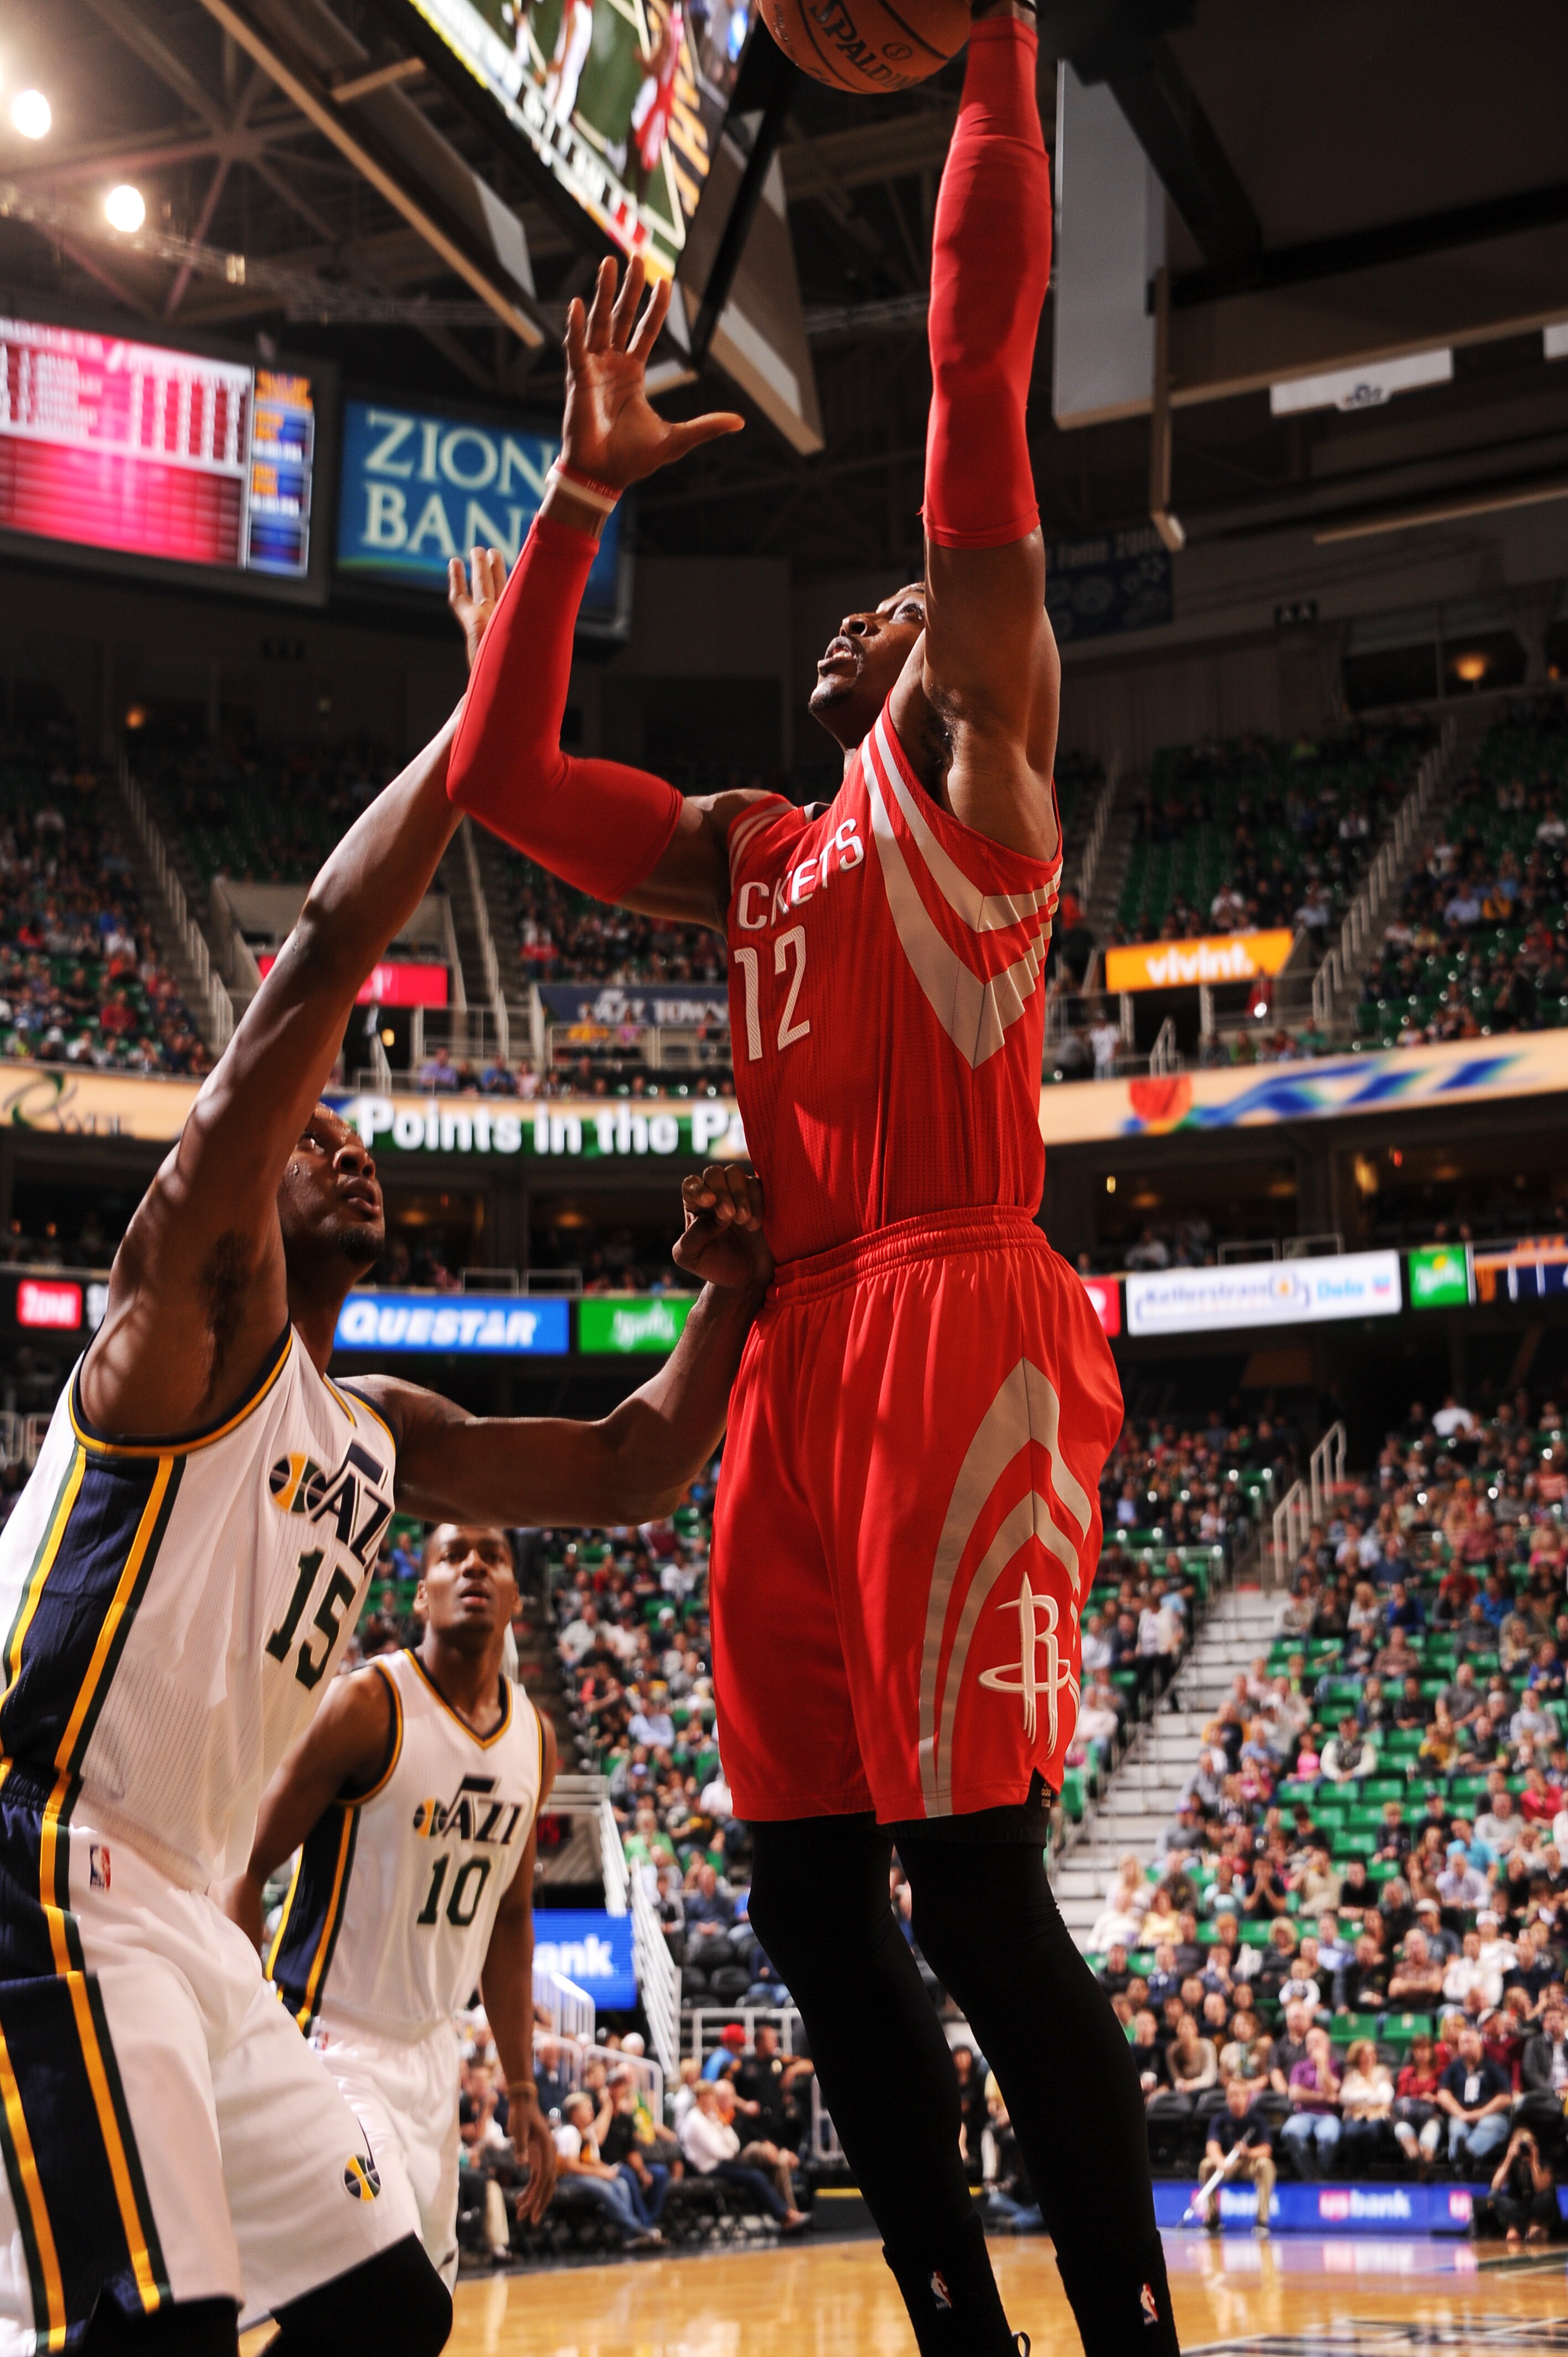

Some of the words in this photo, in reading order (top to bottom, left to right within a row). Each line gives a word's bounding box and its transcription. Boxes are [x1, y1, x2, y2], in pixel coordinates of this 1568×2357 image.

[364, 409, 555, 501] ZION
[361, 480, 538, 569] BAN
[737, 818, 864, 932] CKETS
[734, 925, 810, 1062] 12
[357, 1096, 522, 1152] Points
[534, 1098, 582, 1155] in
[596, 1098, 679, 1155] the
[341, 1300, 537, 1347] QUESTAR
[265, 1545, 357, 1691] 15
[417, 1853, 492, 1926] 10
[533, 1934, 613, 1977] ank
